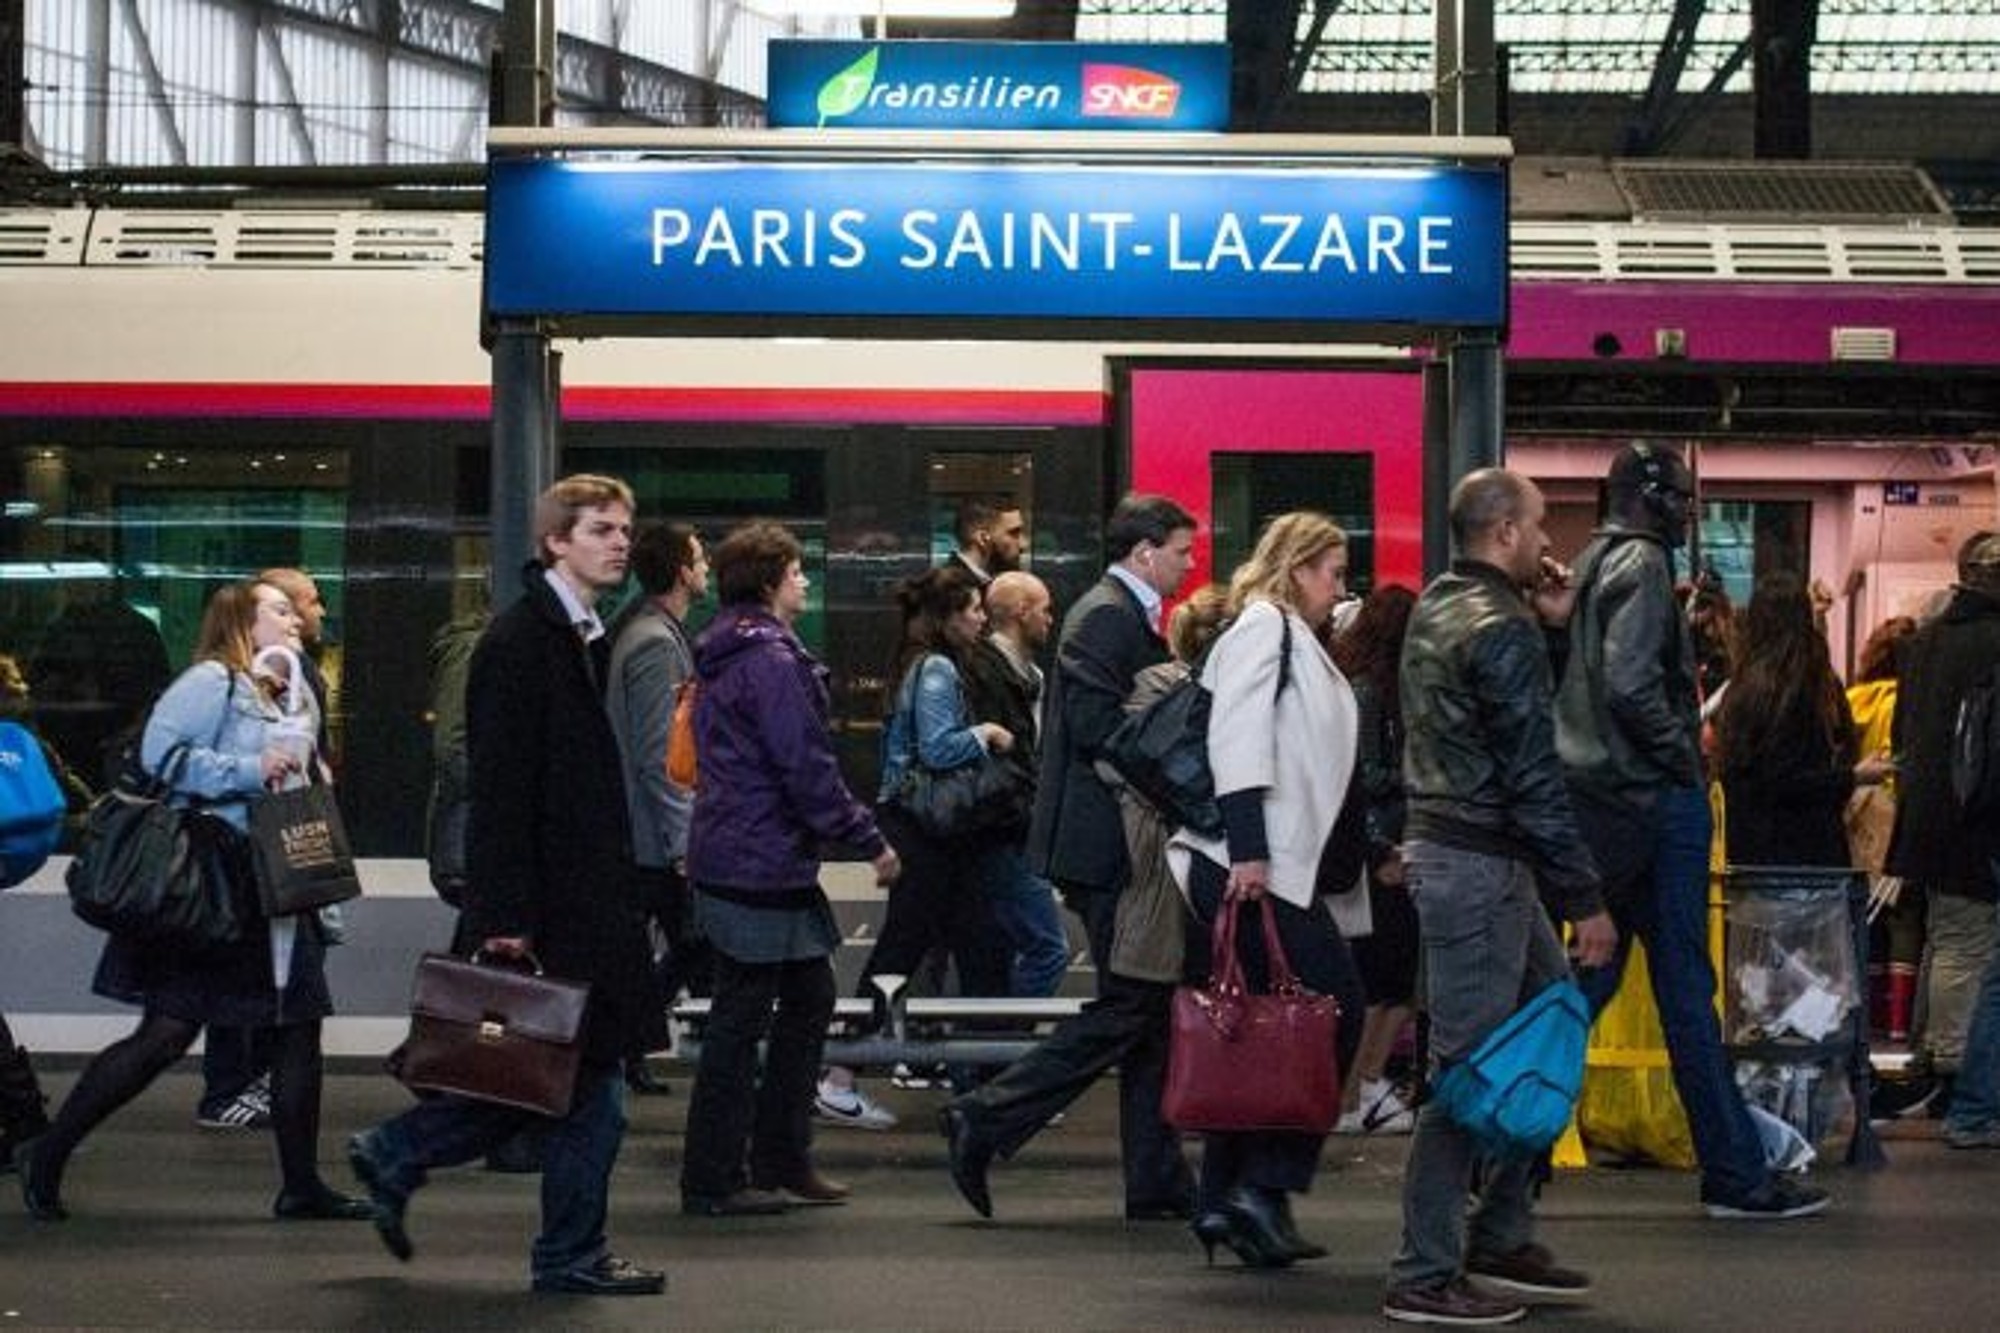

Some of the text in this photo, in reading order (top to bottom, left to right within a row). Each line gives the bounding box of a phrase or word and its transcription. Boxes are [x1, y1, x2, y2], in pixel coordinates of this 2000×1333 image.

[840, 74, 1063, 110] Transilien
[1087, 82, 1173, 112] SNCF
[651, 206, 1454, 275] PARIS SAINT-LAZARE
